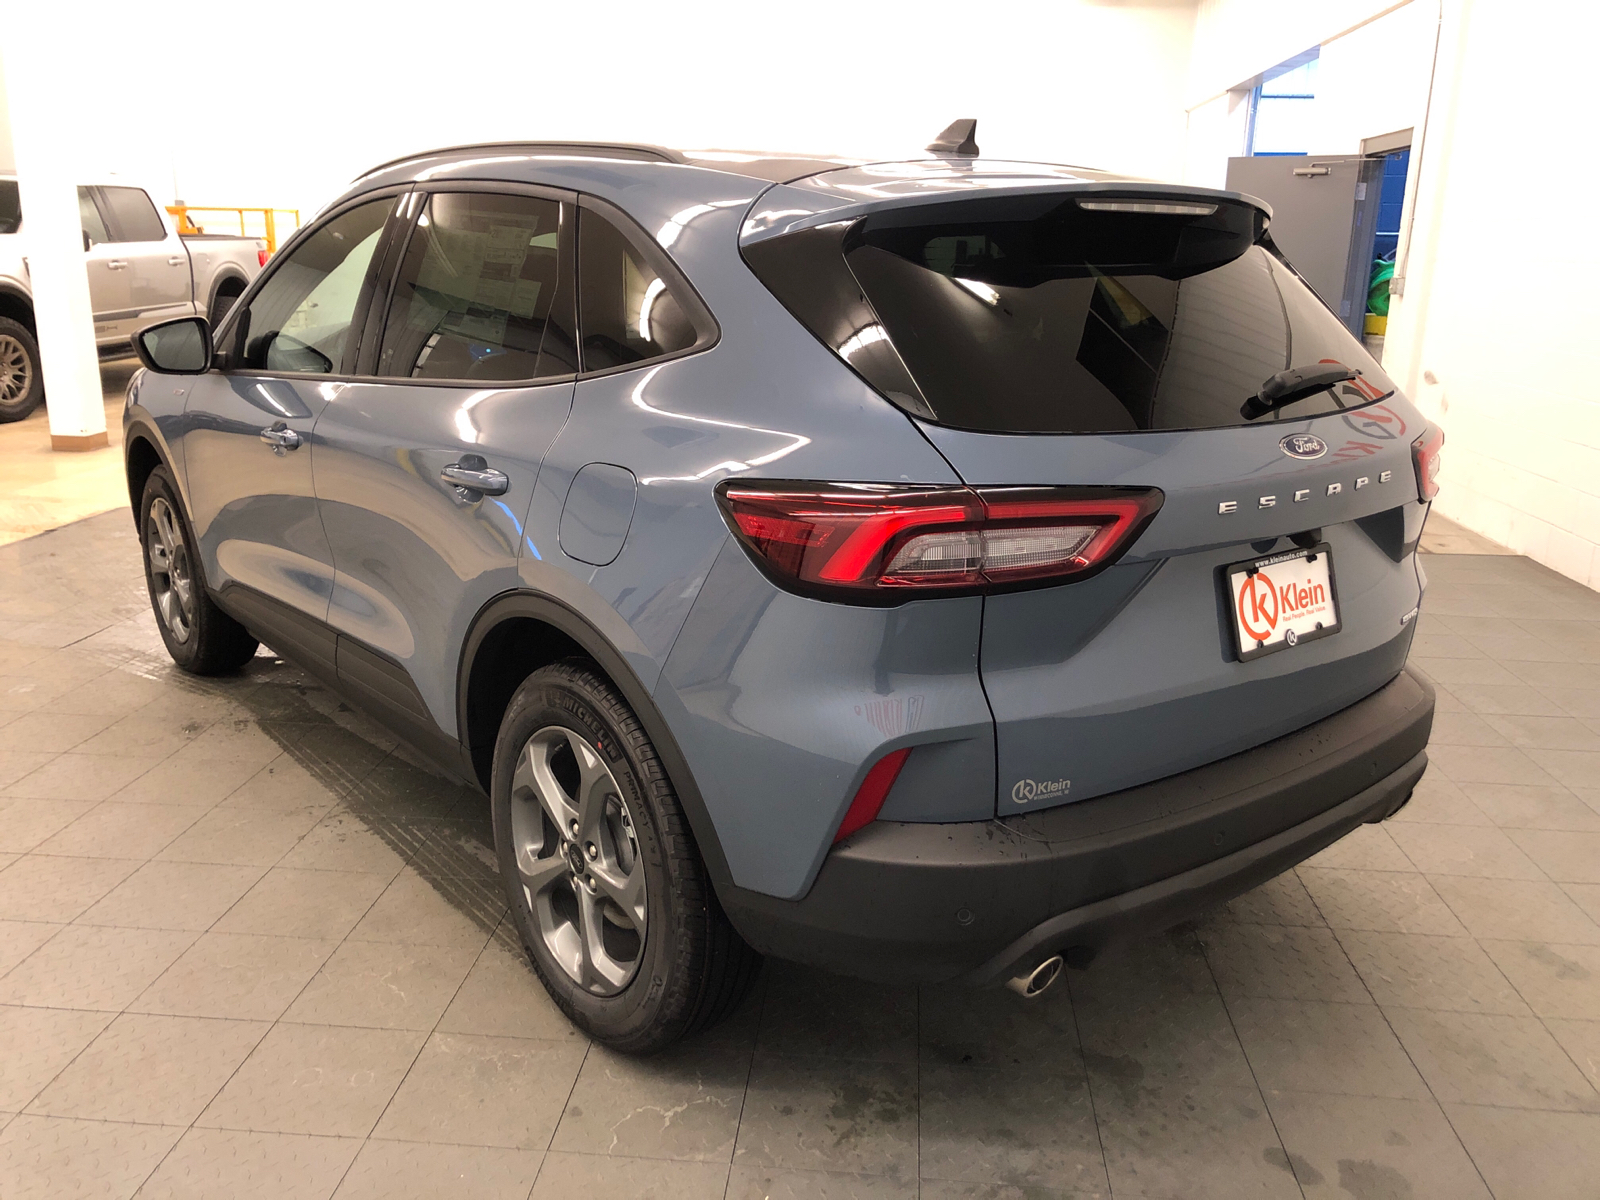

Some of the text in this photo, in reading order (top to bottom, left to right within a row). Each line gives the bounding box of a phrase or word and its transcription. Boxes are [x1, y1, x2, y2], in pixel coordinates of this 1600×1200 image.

[1292, 437, 1320, 454] Ford
[1218, 470, 1391, 515] ESCAPE
[1255, 550, 1308, 568] www.kleinauto.com
[1279, 578, 1325, 614] Klein
[562, 696, 619, 760] MICHELIN
[623, 770, 651, 829] PRIMACY
[1037, 779, 1071, 795] Klein
